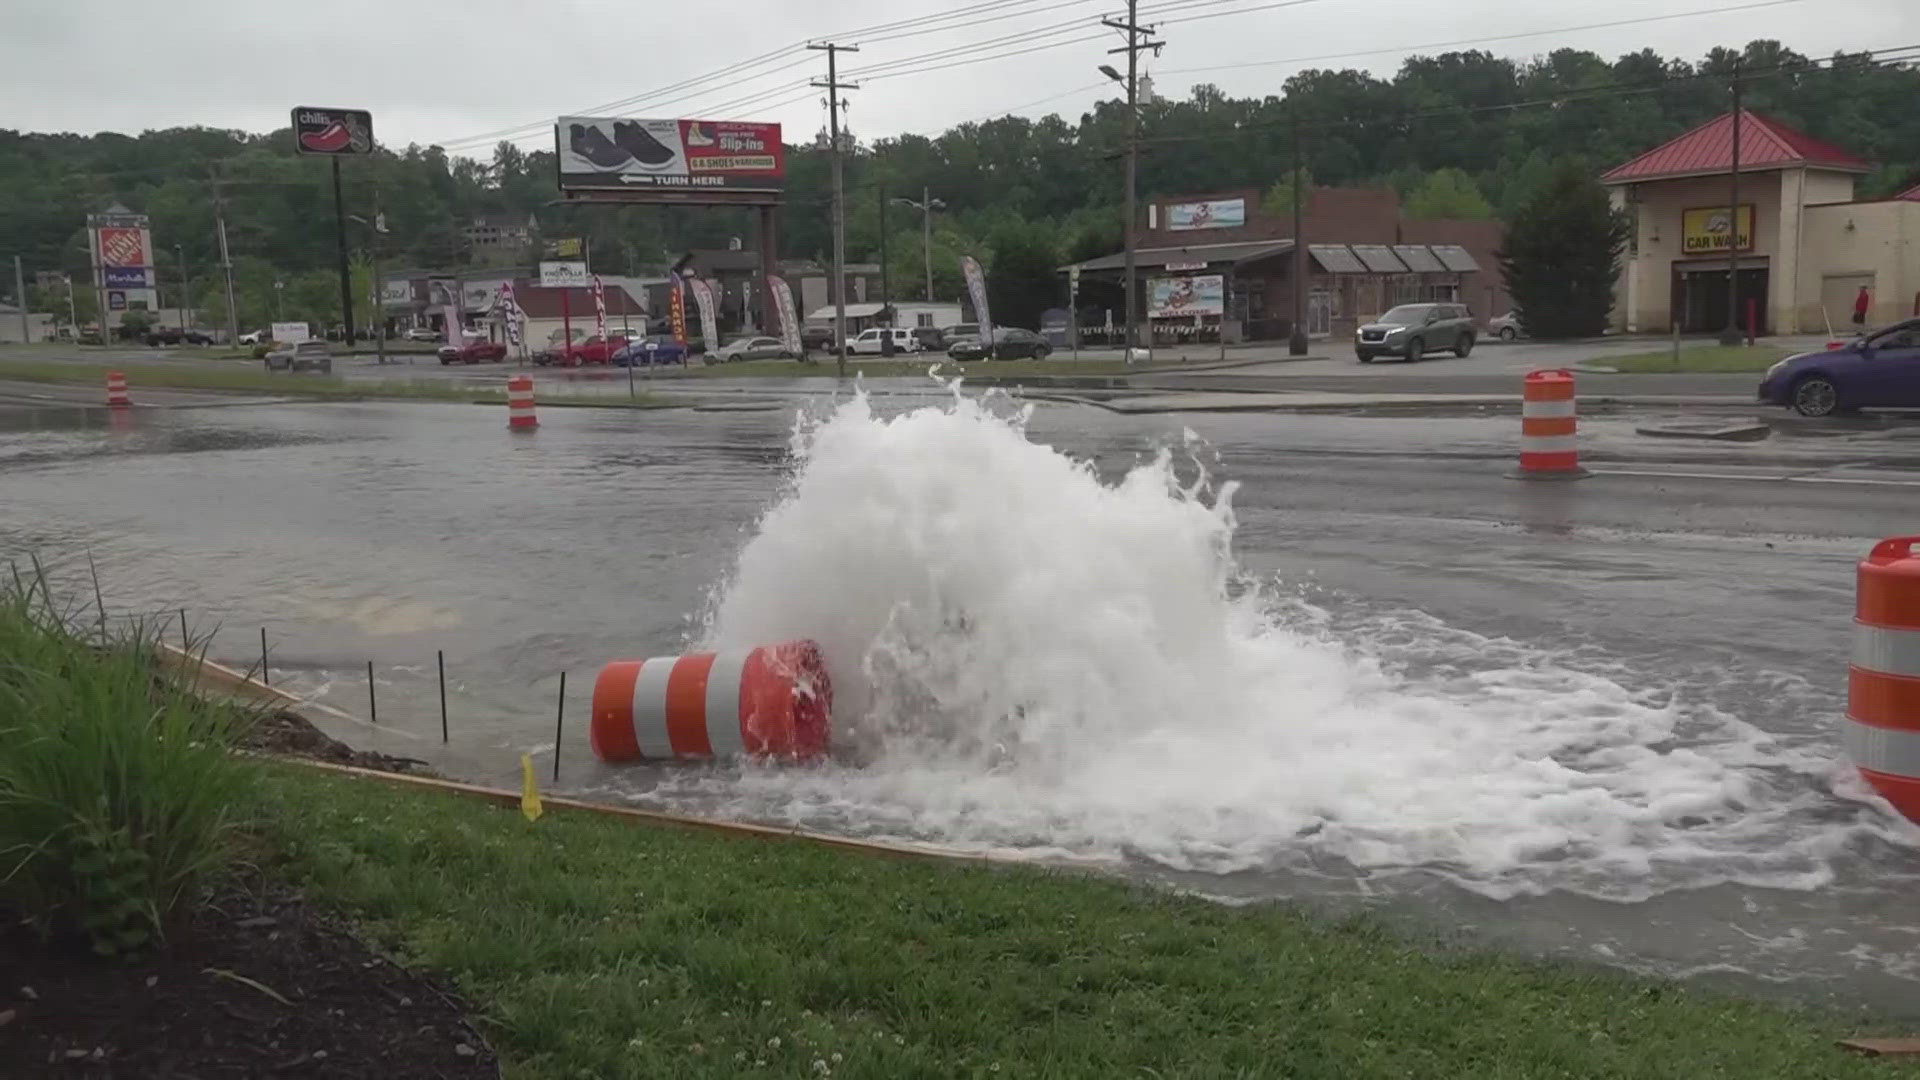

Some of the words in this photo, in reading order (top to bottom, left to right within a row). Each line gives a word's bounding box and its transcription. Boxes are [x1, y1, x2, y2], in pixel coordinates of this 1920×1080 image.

[707, 158, 734, 168] SHOES
[655, 176, 688, 185] TURN
[692, 176, 725, 185] HERE
[103, 231, 139, 262] HOME
[1687, 236, 1710, 249] CAR
[1713, 235, 1748, 249] WAH
